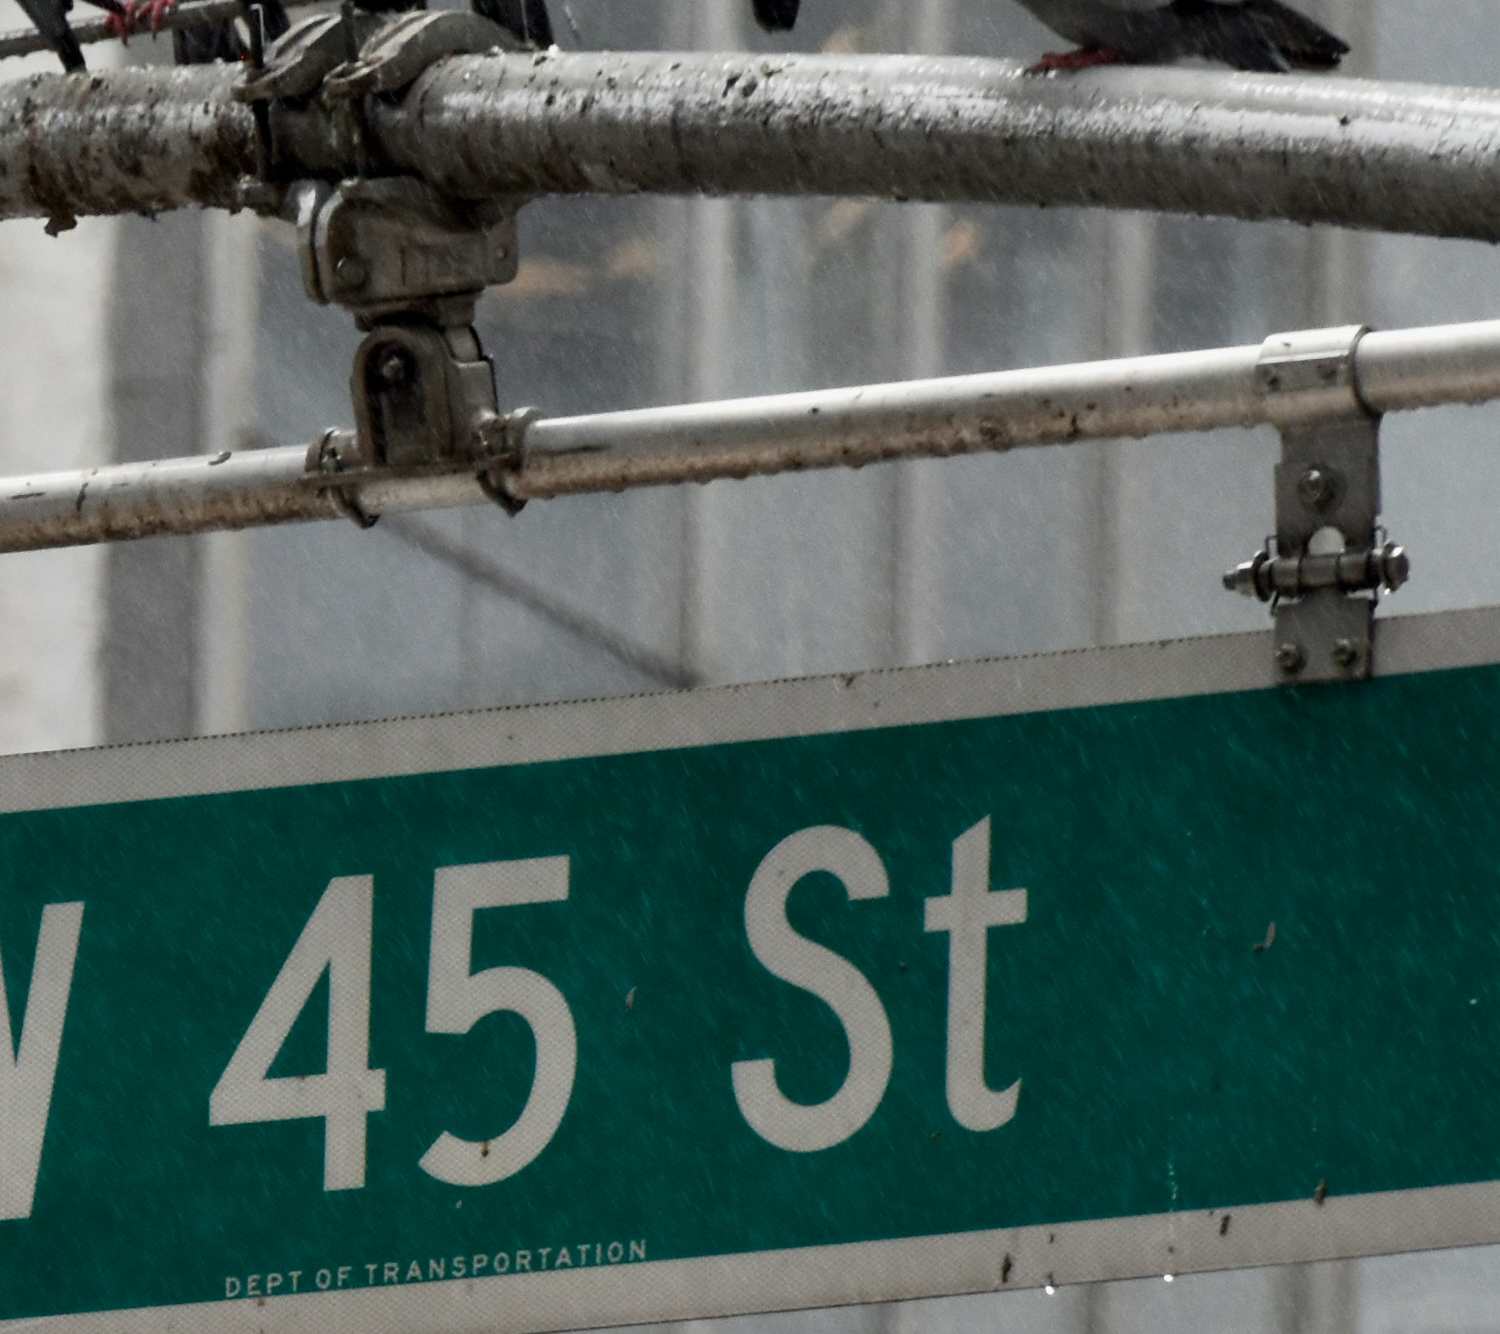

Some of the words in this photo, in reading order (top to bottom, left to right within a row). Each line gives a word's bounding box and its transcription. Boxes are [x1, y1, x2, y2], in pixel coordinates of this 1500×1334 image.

[208, 853, 579, 1193] 45
[730, 814, 1029, 1154] St
[225, 1270, 302, 1298] DEPT
[316, 1265, 352, 1290] OF
[364, 1240, 647, 1286] TRANSPORTATION
